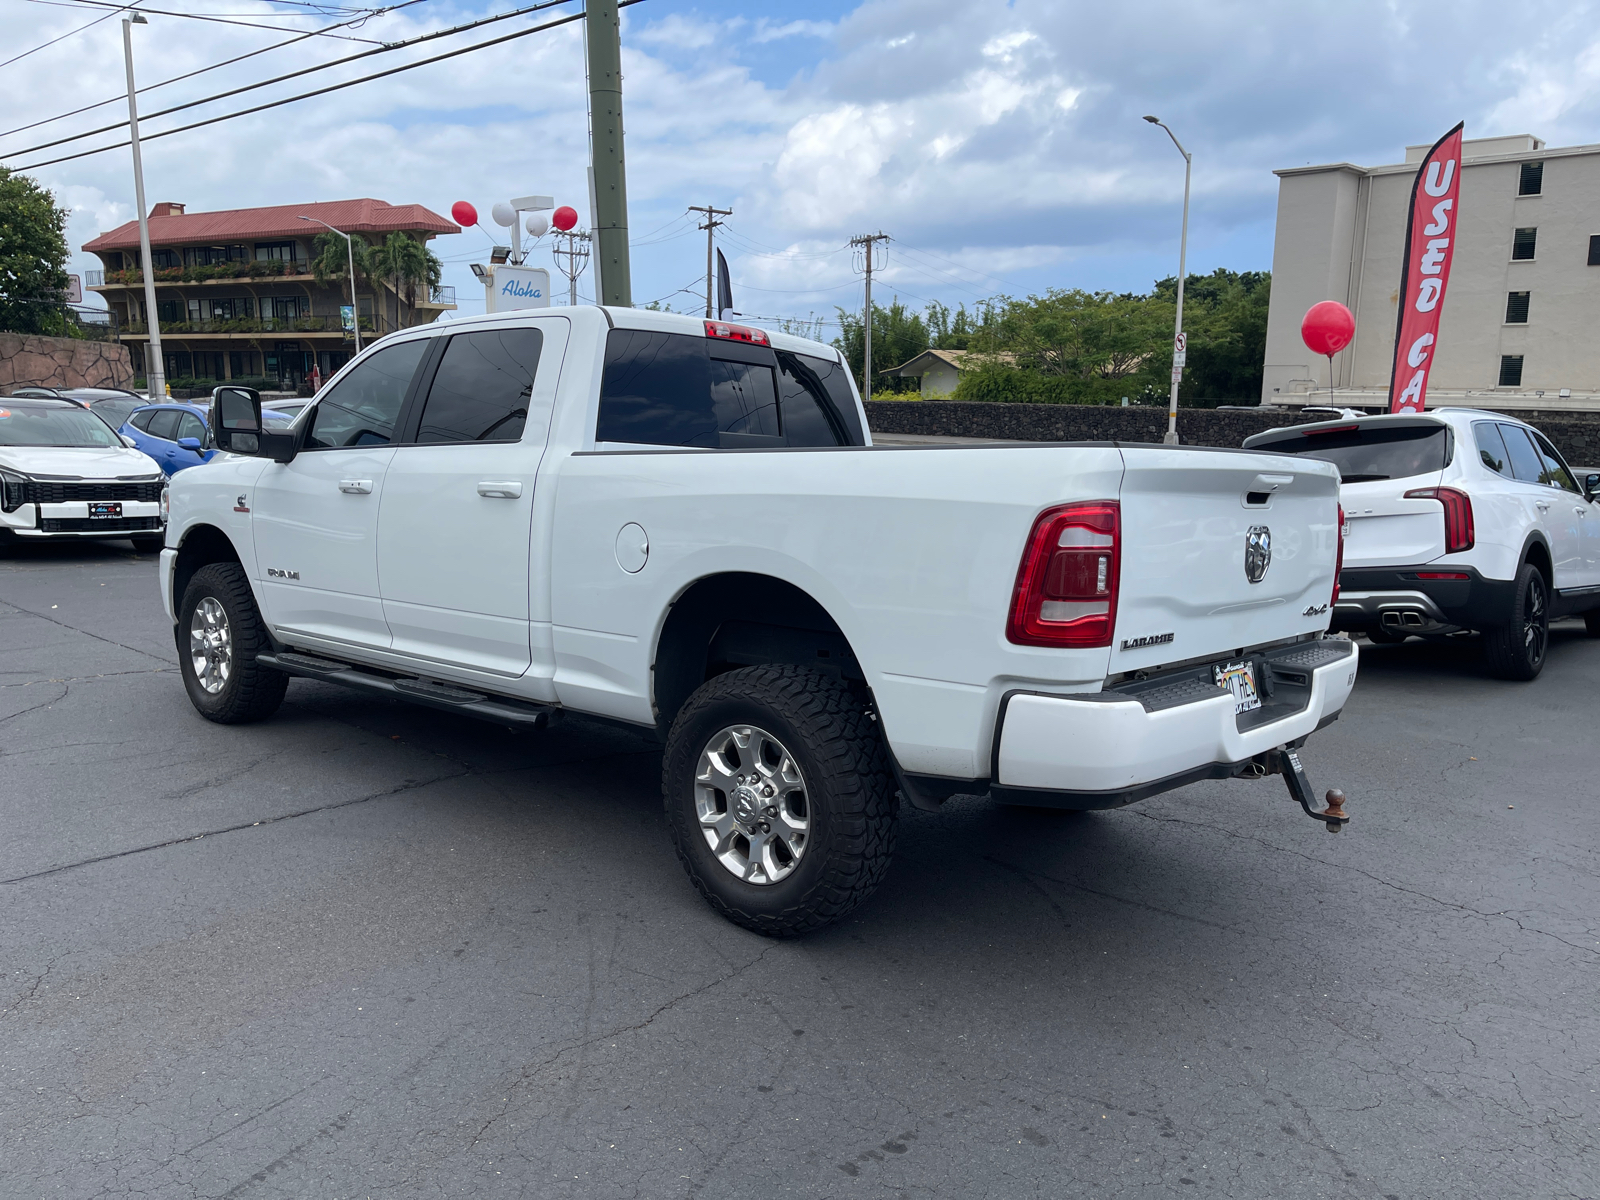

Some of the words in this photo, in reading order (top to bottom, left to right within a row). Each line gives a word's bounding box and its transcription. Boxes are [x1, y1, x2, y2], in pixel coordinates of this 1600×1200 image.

[1415, 159, 1456, 314] USED
[502, 280, 542, 298] Aloha
[1399, 333, 1434, 413] CA
[267, 568, 300, 580] RAM
[1120, 632, 1174, 651] LARAMIE
